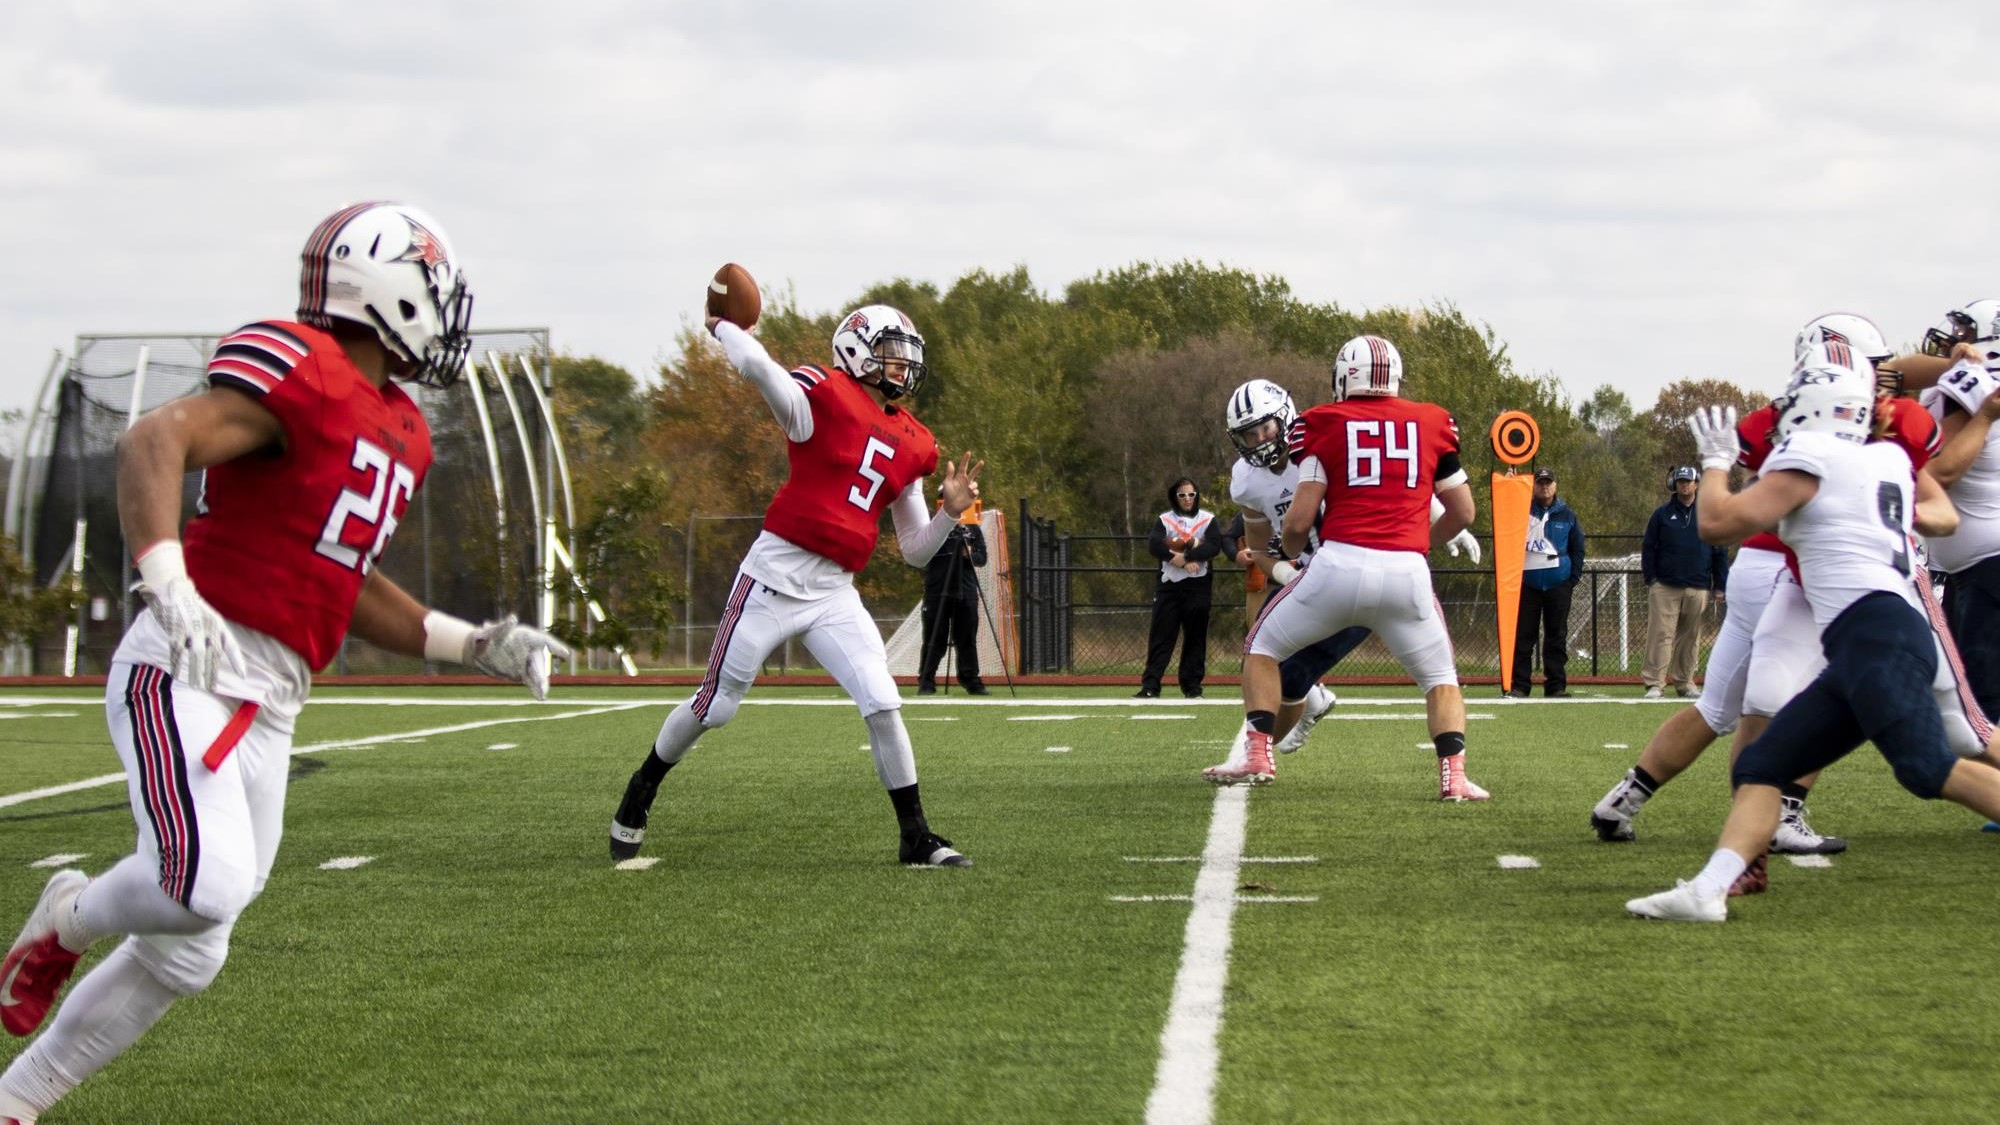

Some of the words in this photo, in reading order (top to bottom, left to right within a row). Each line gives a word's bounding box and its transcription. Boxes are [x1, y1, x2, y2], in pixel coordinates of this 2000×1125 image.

[1855, 406, 1867, 424] 9
[1948, 370, 1979, 393] 93
[847, 435, 896, 513] 5
[1346, 420, 1418, 488] 64
[314, 434, 415, 577] 26
[1878, 481, 1910, 579] 9
